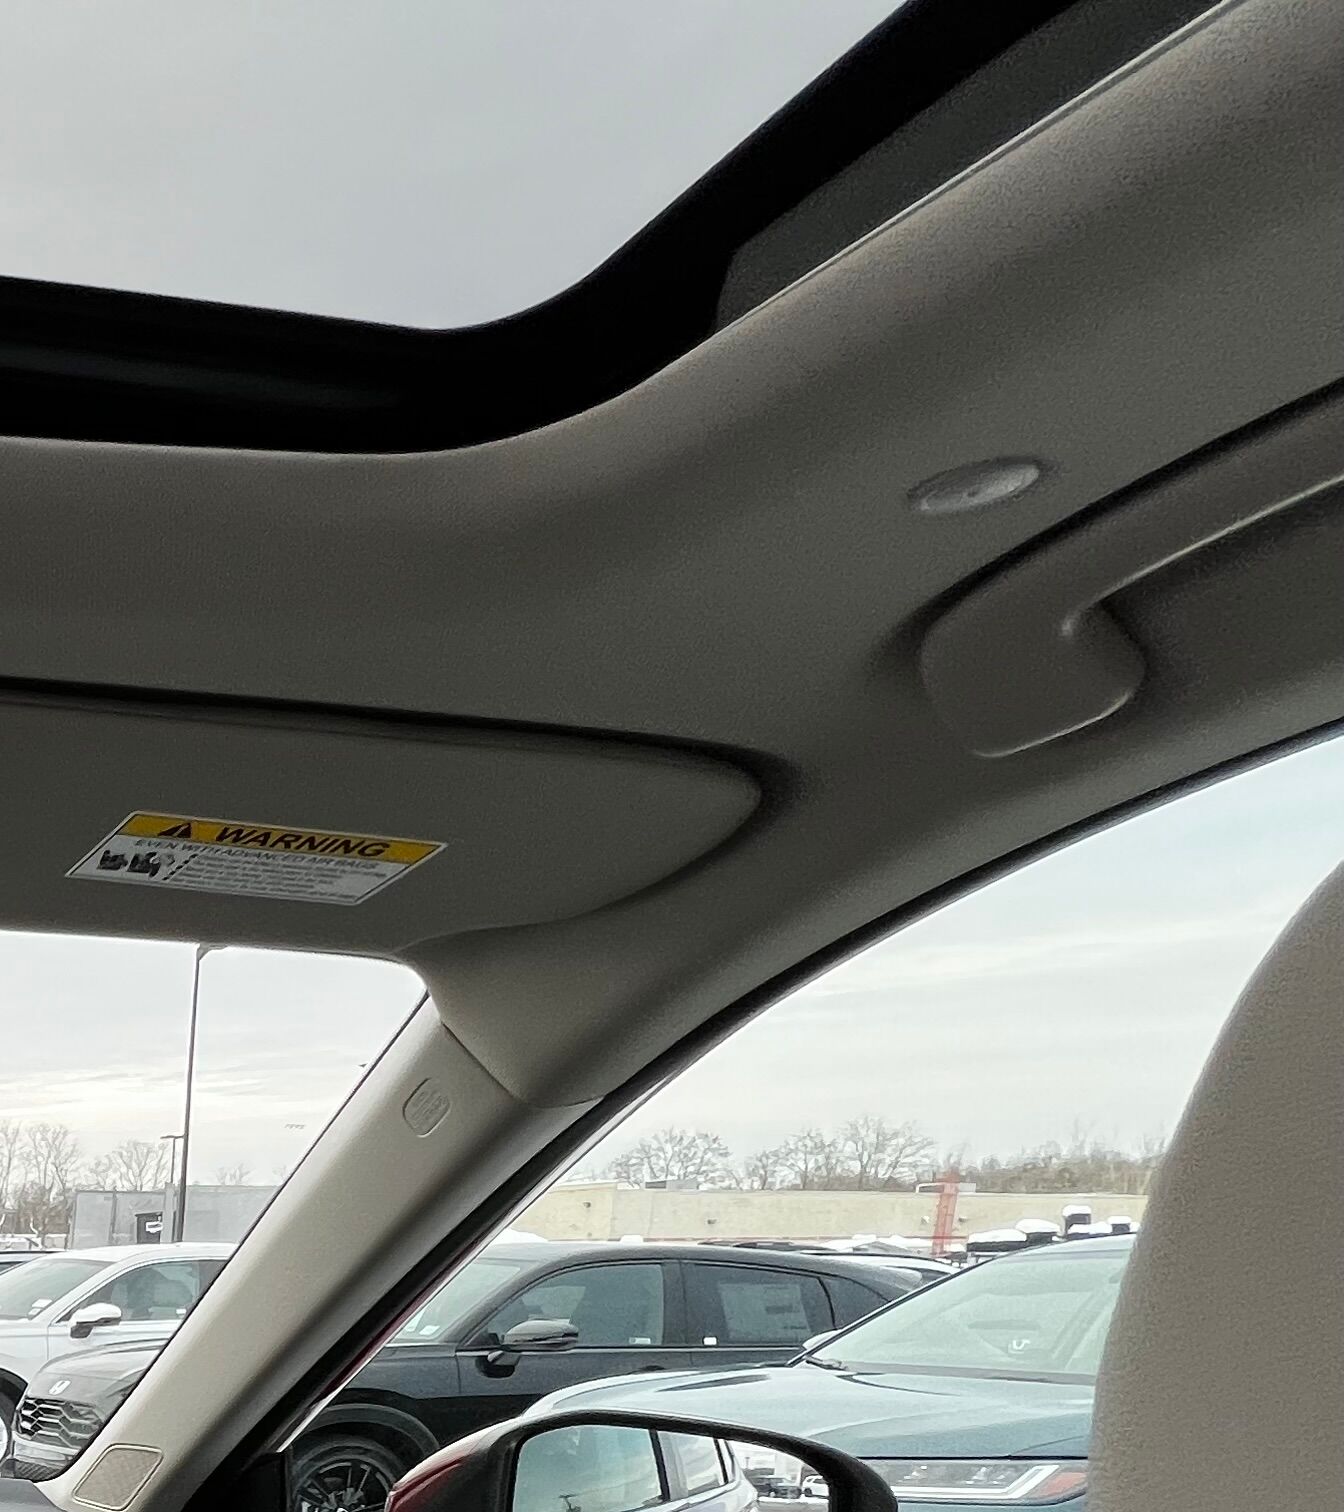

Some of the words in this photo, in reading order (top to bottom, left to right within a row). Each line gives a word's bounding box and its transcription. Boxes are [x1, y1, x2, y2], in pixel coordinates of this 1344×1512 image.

[135, 839, 181, 850] EVEN
[181, 843, 223, 854] WITH
[223, 848, 305, 864] ADVANCED
[306, 855, 337, 865] AIR
[214, 827, 390, 857] WARNING
